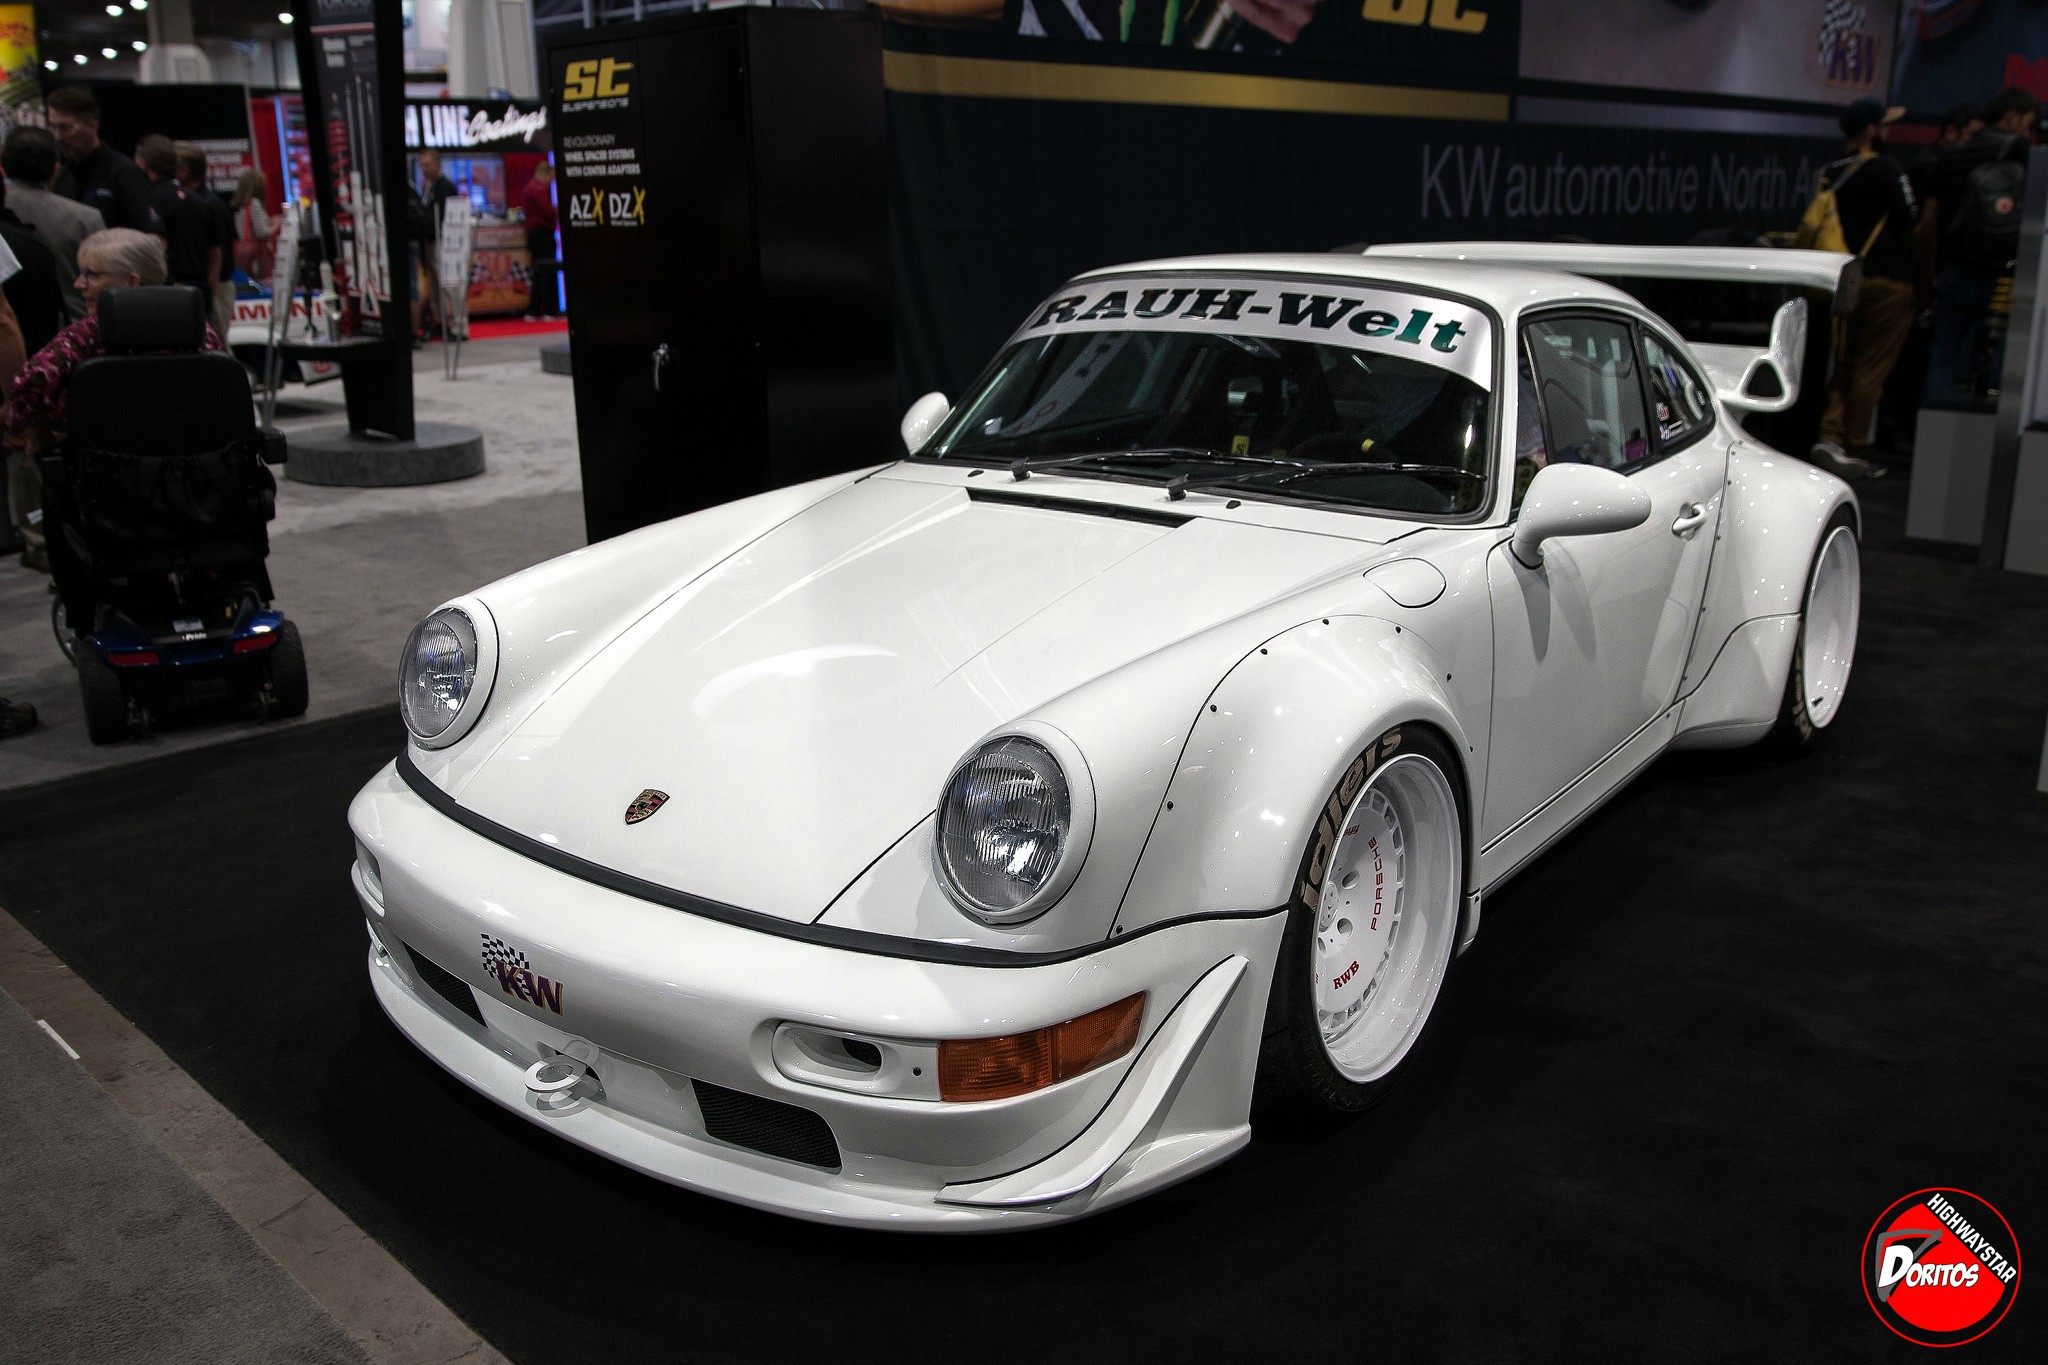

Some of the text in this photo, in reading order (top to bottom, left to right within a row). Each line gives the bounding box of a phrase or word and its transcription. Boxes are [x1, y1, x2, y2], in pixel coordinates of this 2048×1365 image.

[421, 104, 470, 147] LINE
[467, 104, 547, 146] Coatings
[564, 147, 636, 163] WHEEL SPACER SYSTEMS
[565, 162, 641, 177] WITH CENTER ADAPTERS
[1421, 144, 1820, 219] KW automotive North A
[569, 183, 646, 225] AZX DZX
[1029, 287, 1468, 354] RAUH-Welt
[1367, 836, 1384, 932] PORSCHE
[495, 959, 564, 1017] KW
[1332, 960, 1361, 990] RWB
